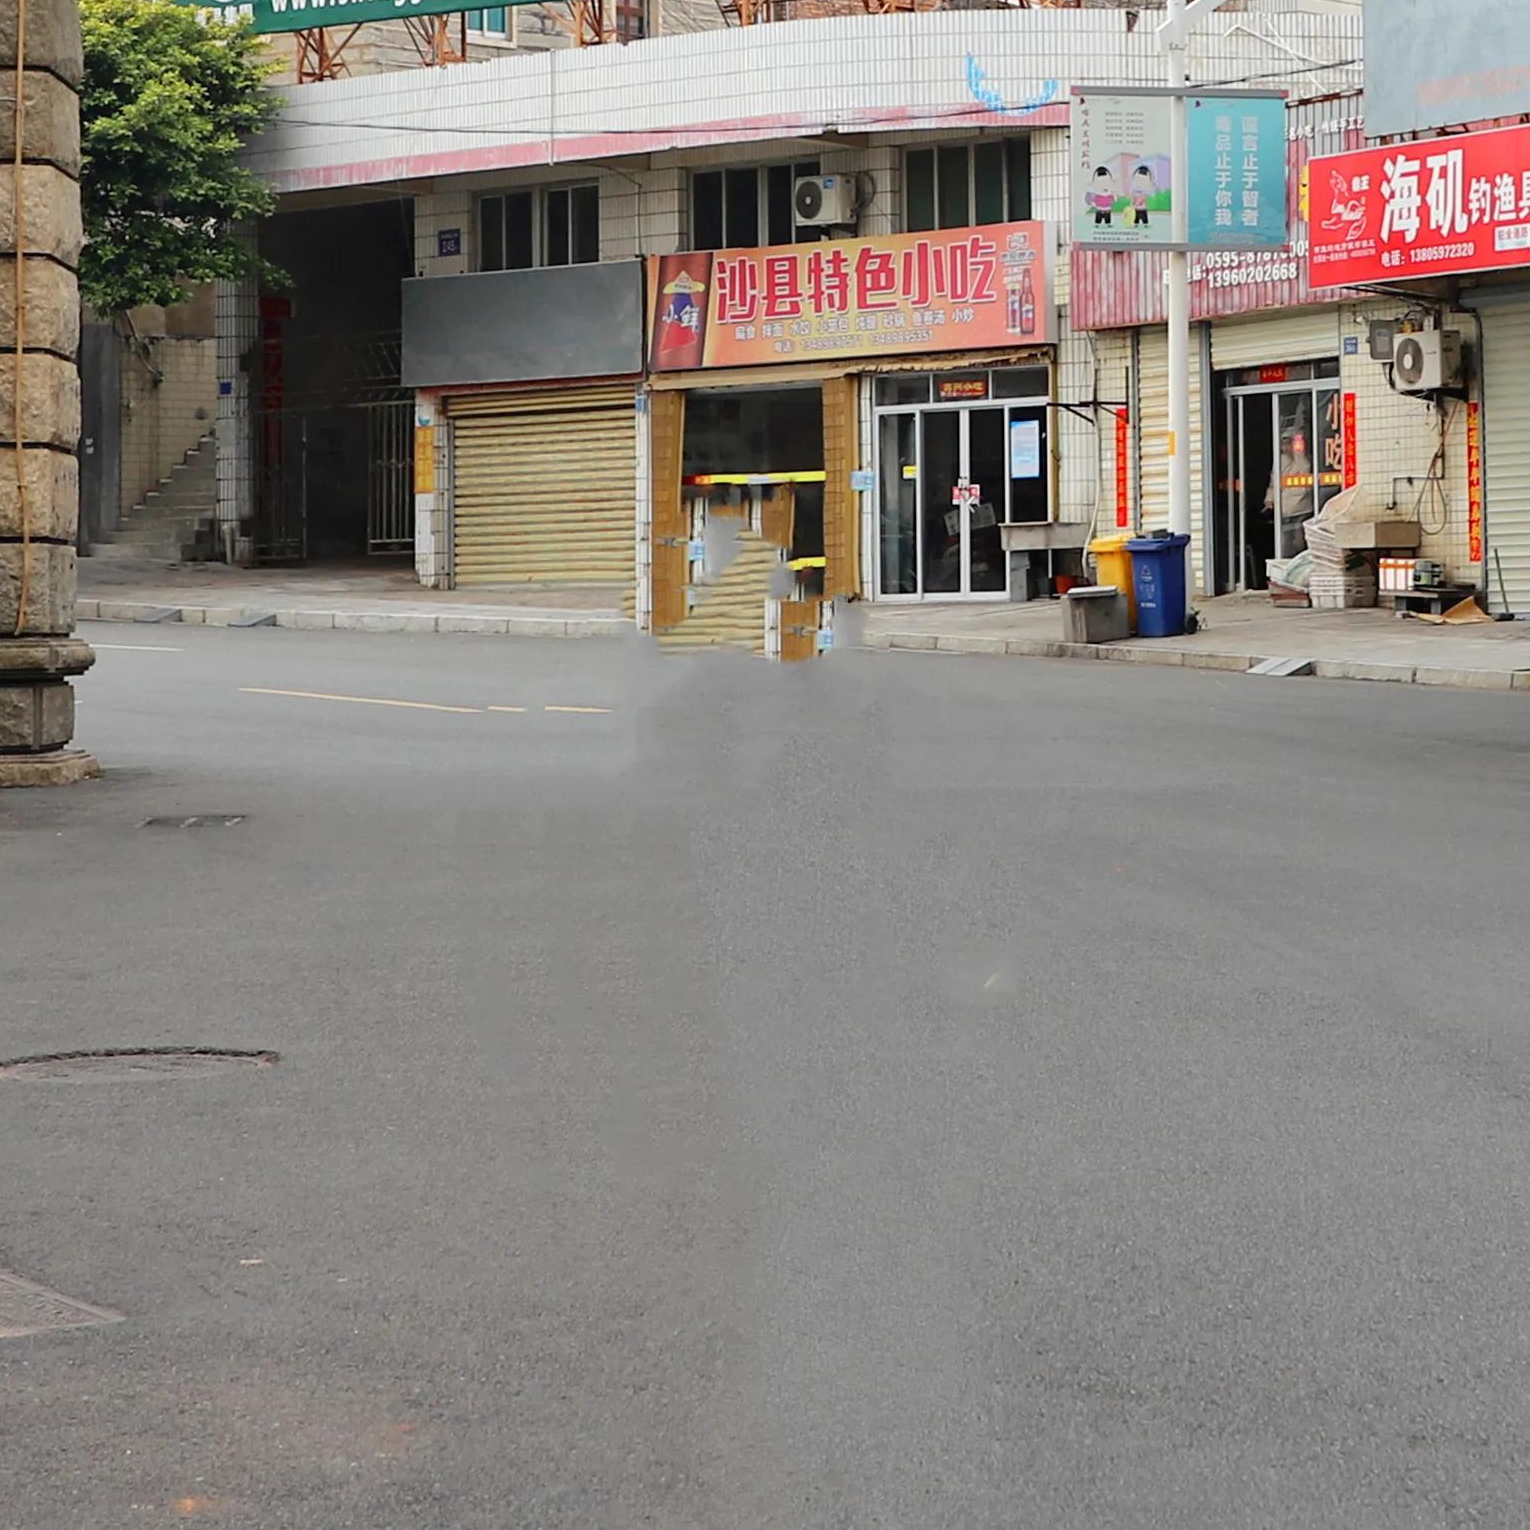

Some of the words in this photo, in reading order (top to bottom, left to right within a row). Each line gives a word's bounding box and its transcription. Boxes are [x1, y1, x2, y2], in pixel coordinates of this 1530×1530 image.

[715, 234, 998, 325] 沙县特色小吃
[1208, 261, 1298, 288] 13960202668
